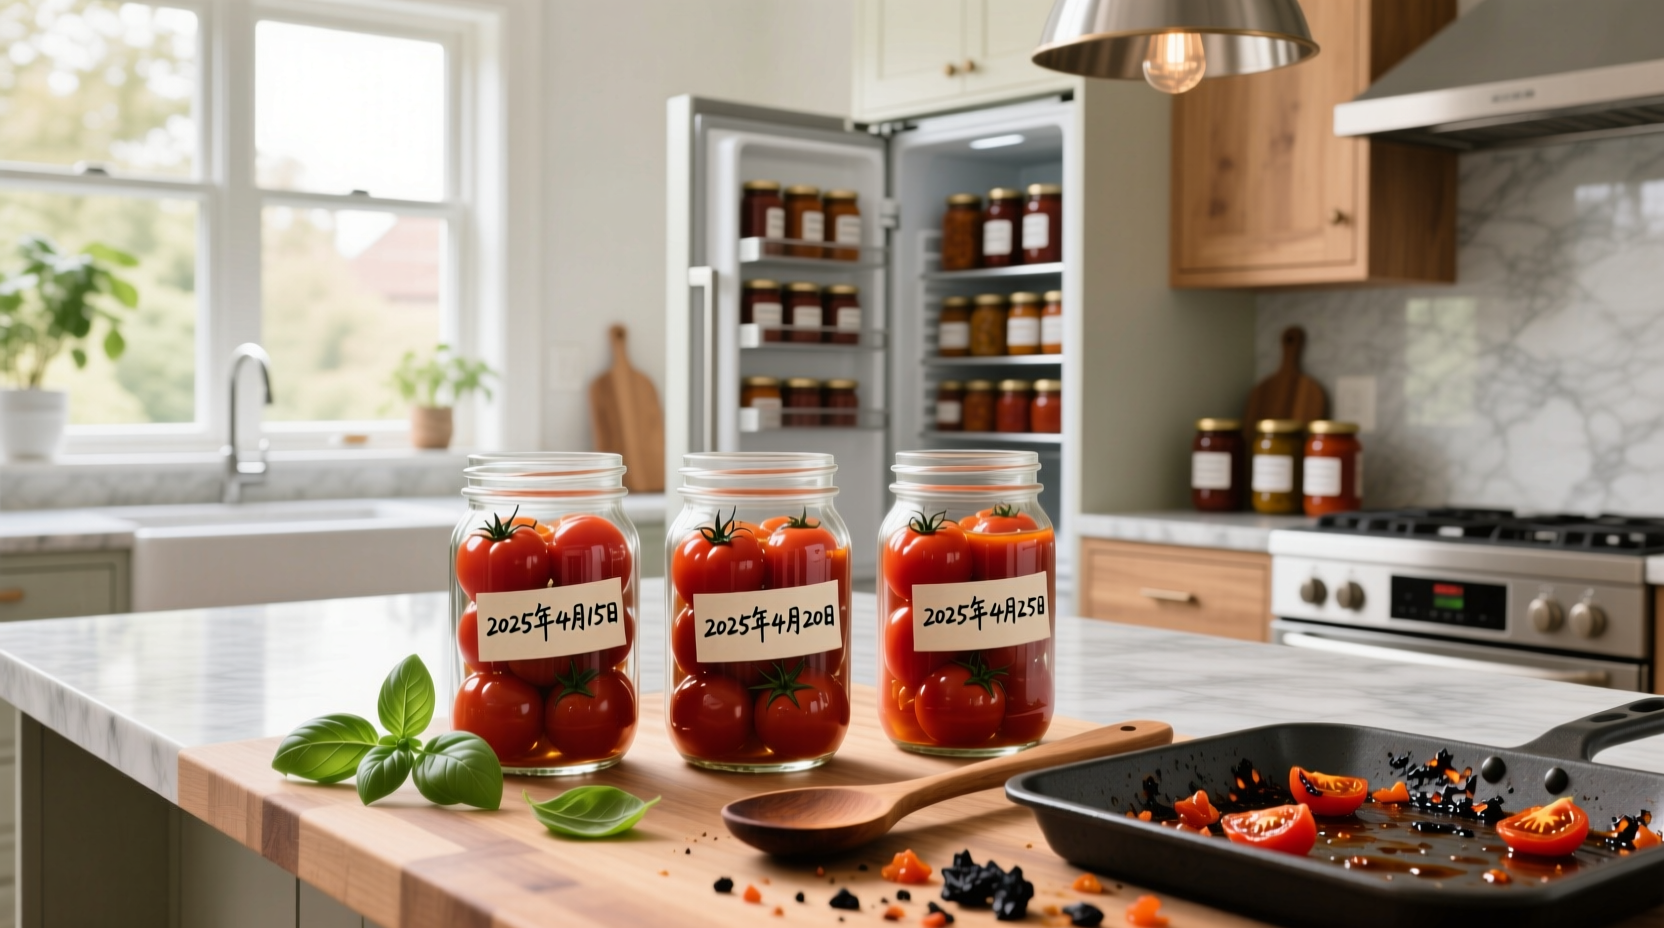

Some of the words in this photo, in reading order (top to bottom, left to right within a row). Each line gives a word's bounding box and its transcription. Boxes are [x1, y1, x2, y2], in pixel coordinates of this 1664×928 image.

[486, 602, 618, 642] 2025年4月15日
[704, 604, 835, 643] 2025年4月20日
[923, 595, 1045, 631] 2025年4月25日
